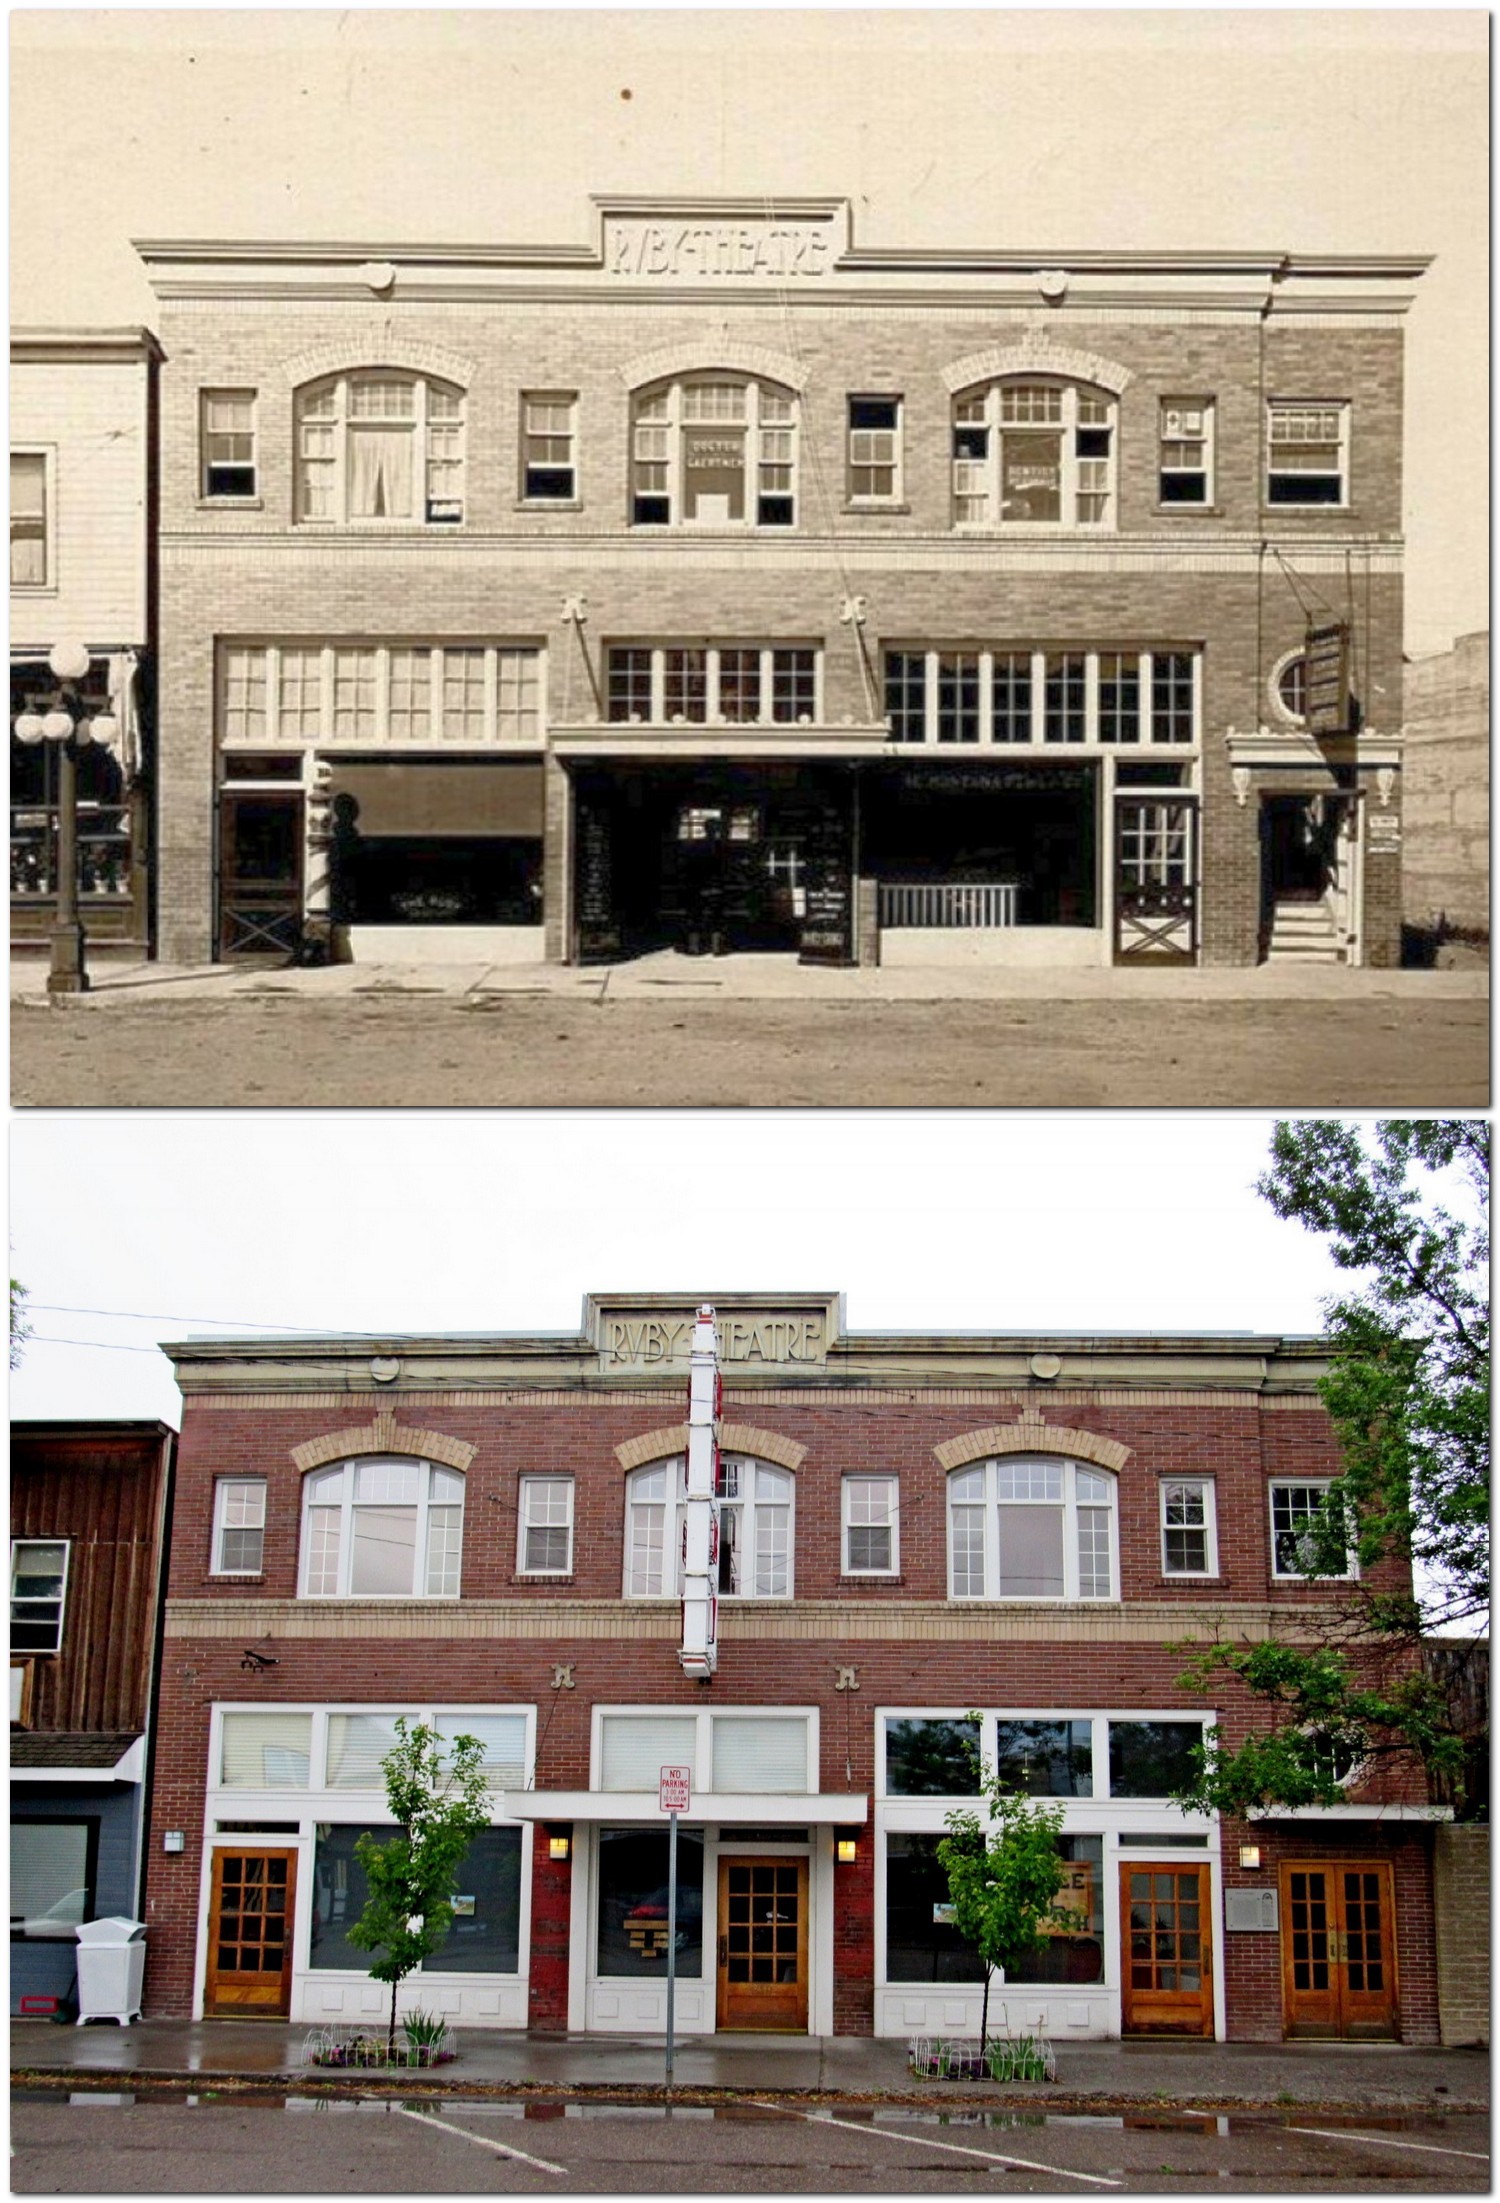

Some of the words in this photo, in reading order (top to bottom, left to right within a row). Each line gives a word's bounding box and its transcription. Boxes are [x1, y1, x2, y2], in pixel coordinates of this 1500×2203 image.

[692, 228, 828, 277] THEATRE
[688, 1322, 821, 1364] EATRE
[662, 1779, 688, 1789] PARKING
[670, 1769, 681, 1778] NO
